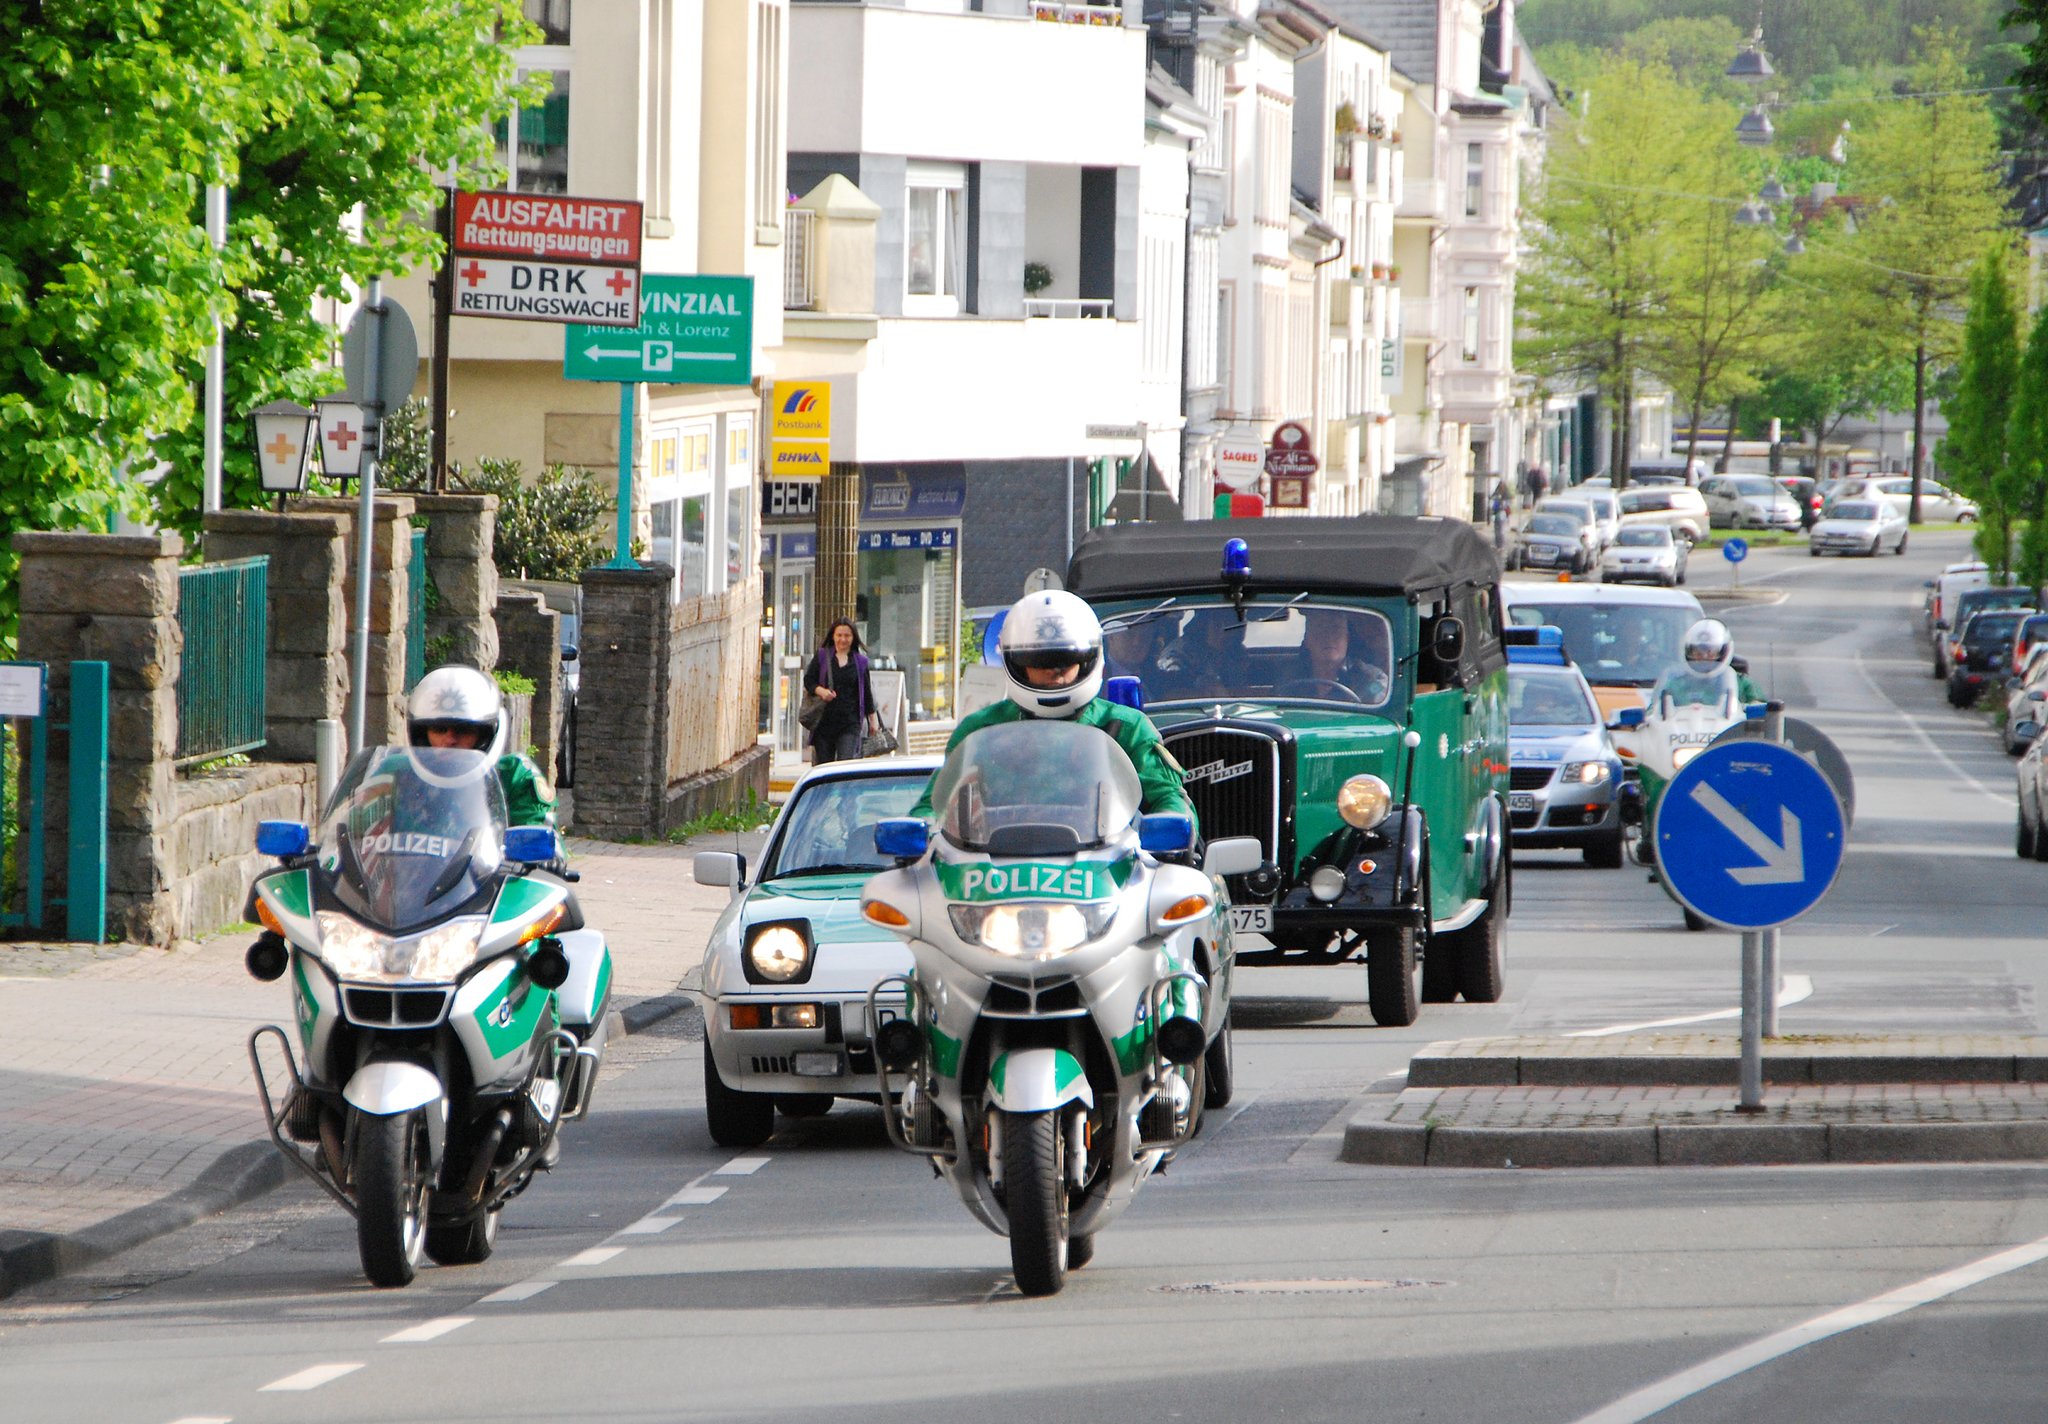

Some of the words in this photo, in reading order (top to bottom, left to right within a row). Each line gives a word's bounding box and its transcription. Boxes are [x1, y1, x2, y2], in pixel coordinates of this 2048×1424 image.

[471, 197, 626, 232] AUSFAHRT
[463, 223, 629, 258] Rettungswagen
[510, 265, 587, 294] DRK
[460, 292, 630, 318] RETTUNGSWACHE
[676, 322, 730, 337] Lorenz
[777, 419, 822, 429] Postbank
[1223, 450, 1258, 462] SAGRES
[1186, 762, 1222, 780] OPEL
[1214, 763, 1250, 780] BLITZ
[361, 831, 449, 858] POLIZEI
[963, 866, 1094, 899] POLIZEI
